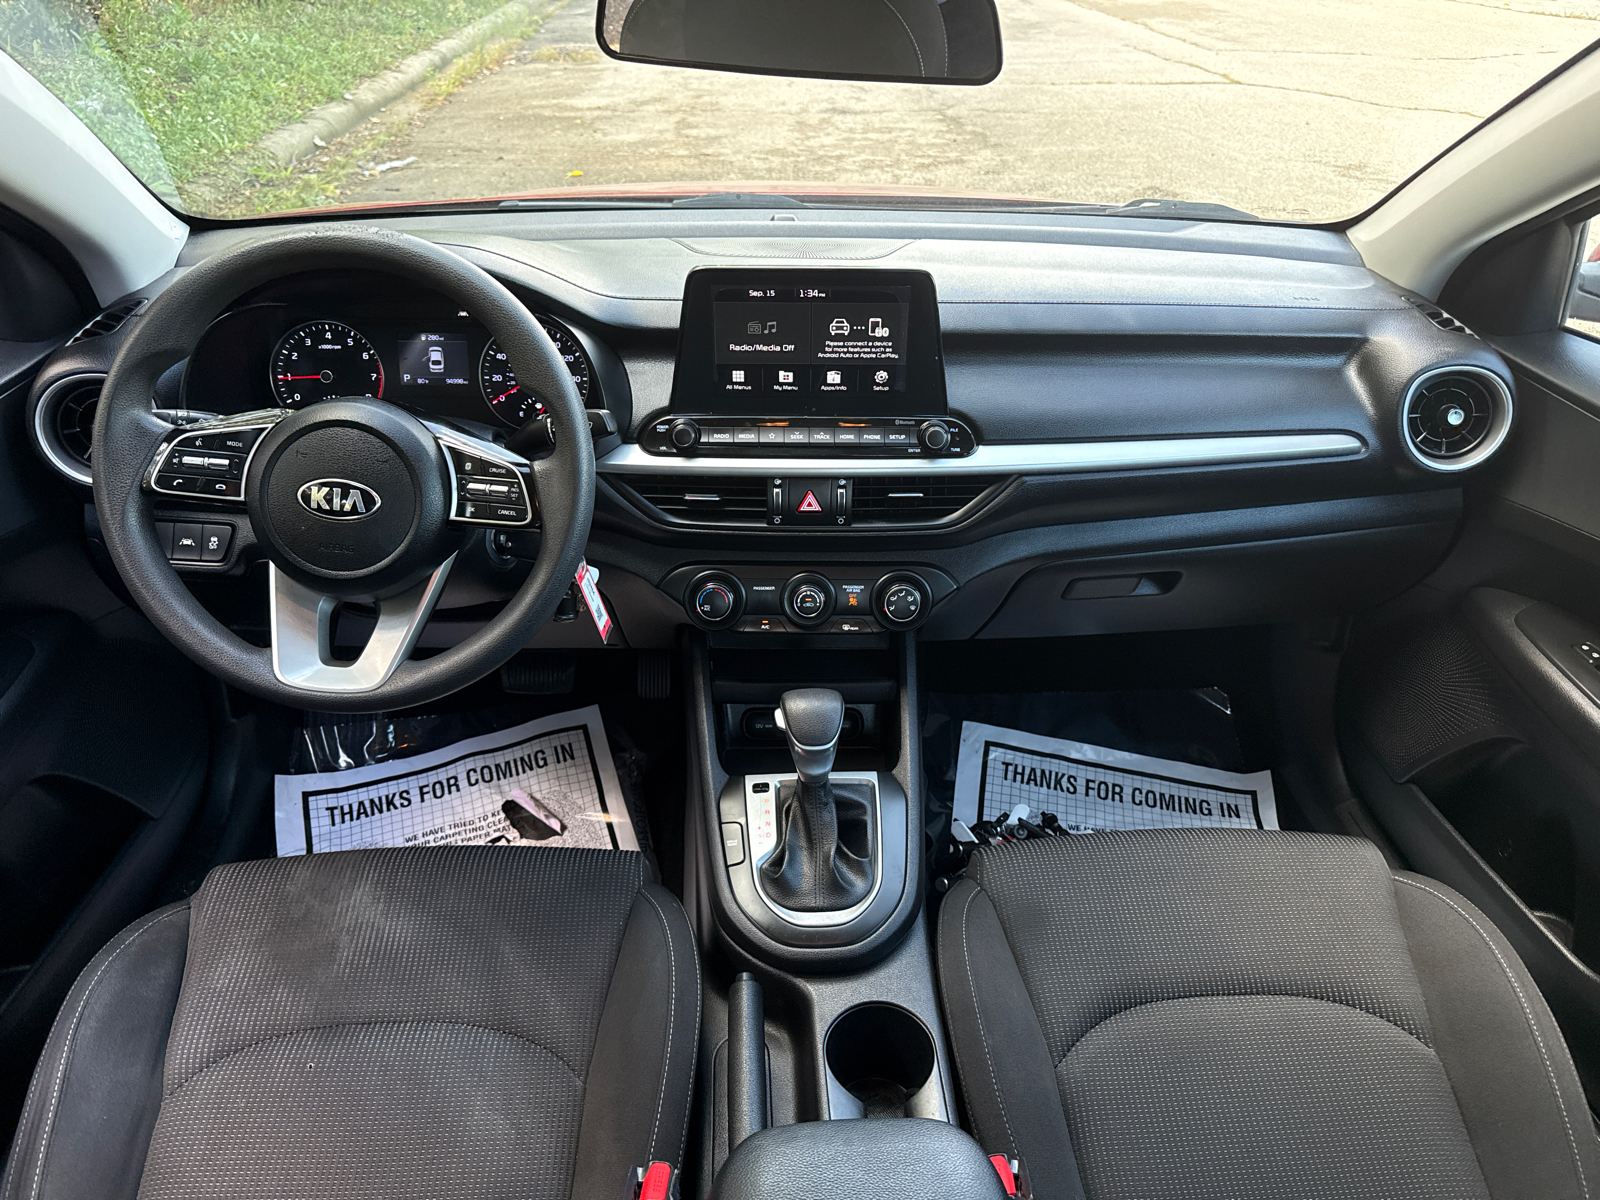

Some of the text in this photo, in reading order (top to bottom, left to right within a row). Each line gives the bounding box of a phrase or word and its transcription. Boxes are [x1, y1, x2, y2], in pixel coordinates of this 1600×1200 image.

[749, 289, 764, 298] Sep.
[325, 332, 332, 340] 4
[729, 344, 795, 352] Radio/Media Off
[404, 374, 410, 382] P
[294, 393, 300, 401] 0
[310, 486, 366, 512] KIA
[325, 743, 576, 827] THANKS FOR COMING IN
[1001, 761, 1241, 819] THANKS FOR COMING IN
[404, 834, 419, 843] WE
[422, 826, 445, 838] HAVE
[448, 820, 474, 830] TRIED
[477, 814, 489, 823] TO
[434, 825, 484, 843] CARPETING
[487, 816, 509, 828] CLEA
[1068, 823, 1081, 831] WE
[461, 831, 490, 844] PAPER
